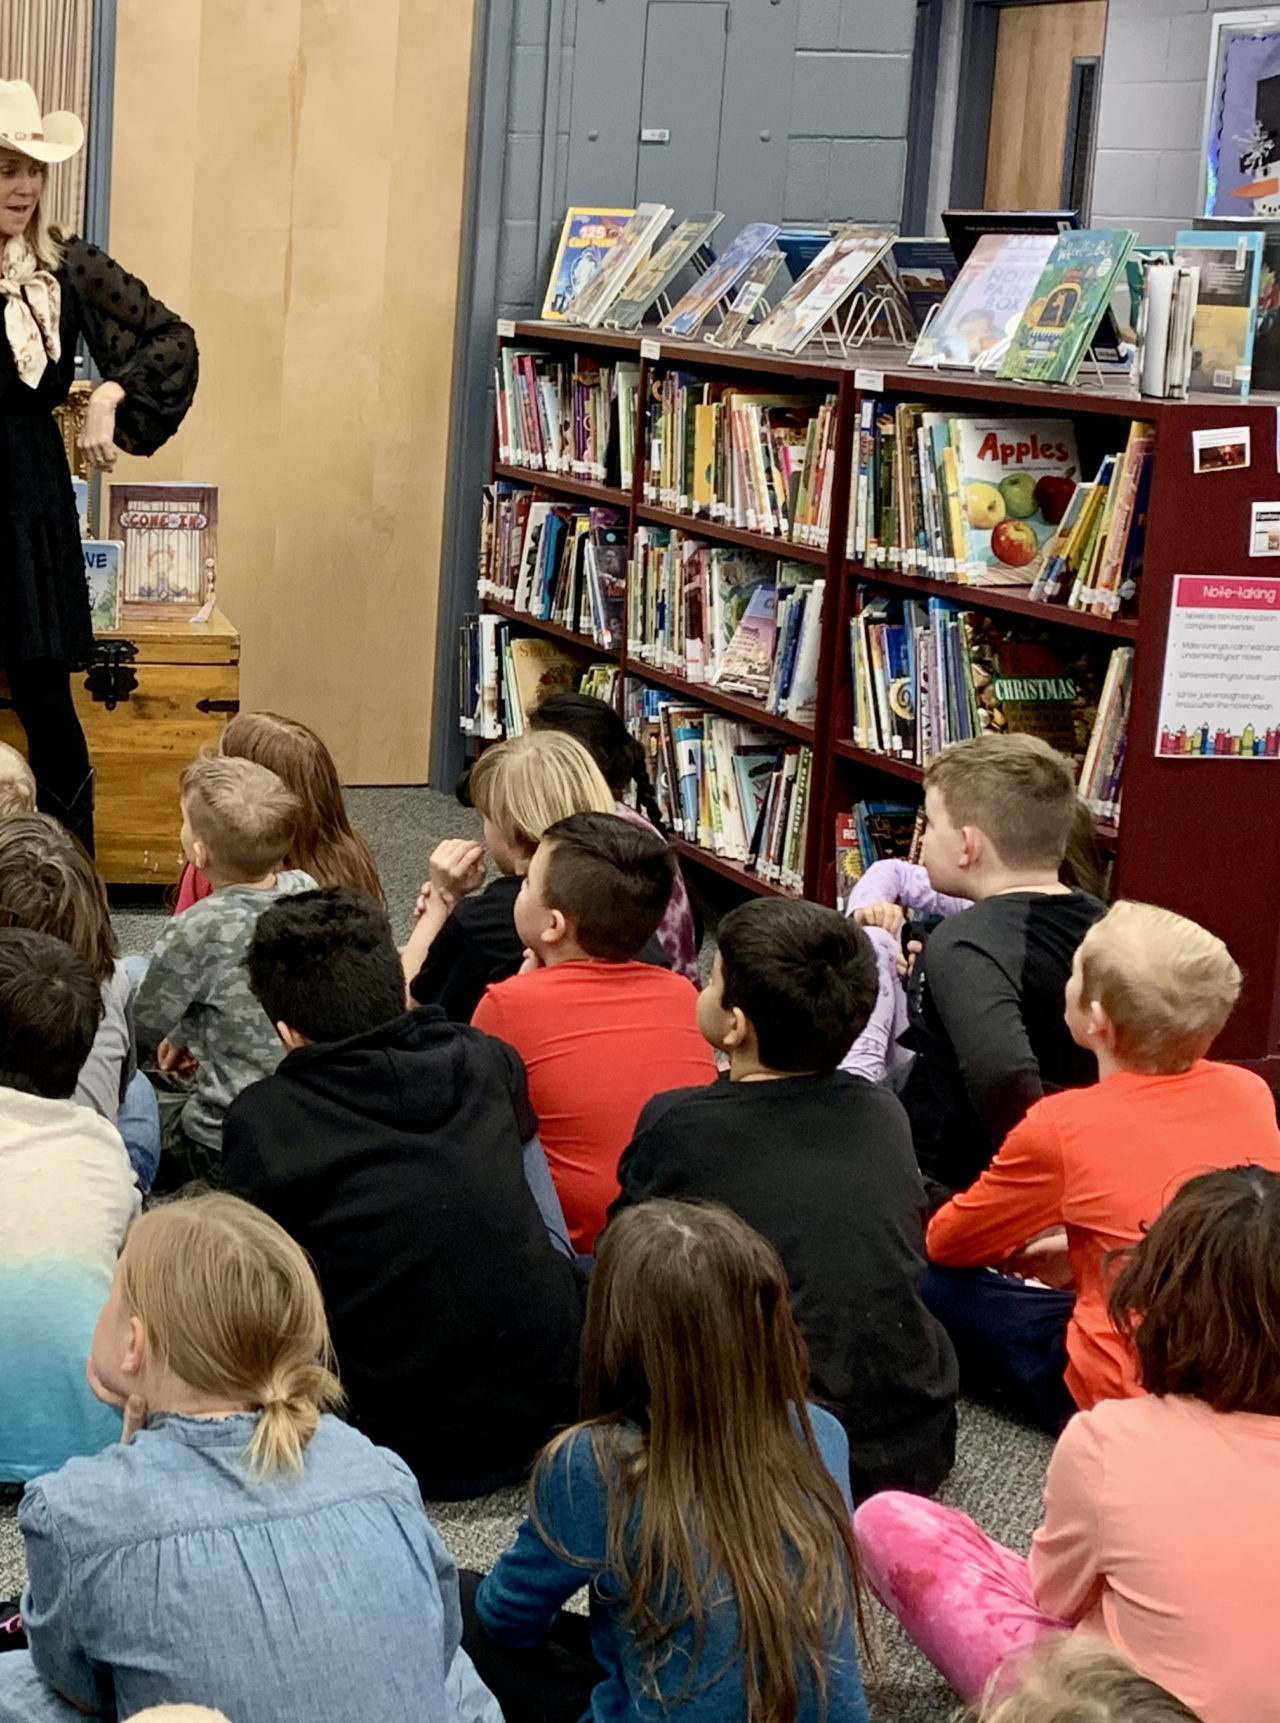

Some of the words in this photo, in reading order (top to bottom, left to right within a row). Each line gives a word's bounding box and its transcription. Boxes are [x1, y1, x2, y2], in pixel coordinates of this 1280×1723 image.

[977, 432, 1069, 465] Apples
[130, 514, 168, 527] COME
[179, 514, 199, 528] IN
[1203, 585, 1277, 604] Note-taking
[995, 678, 1076, 701] CHRISTMAS
